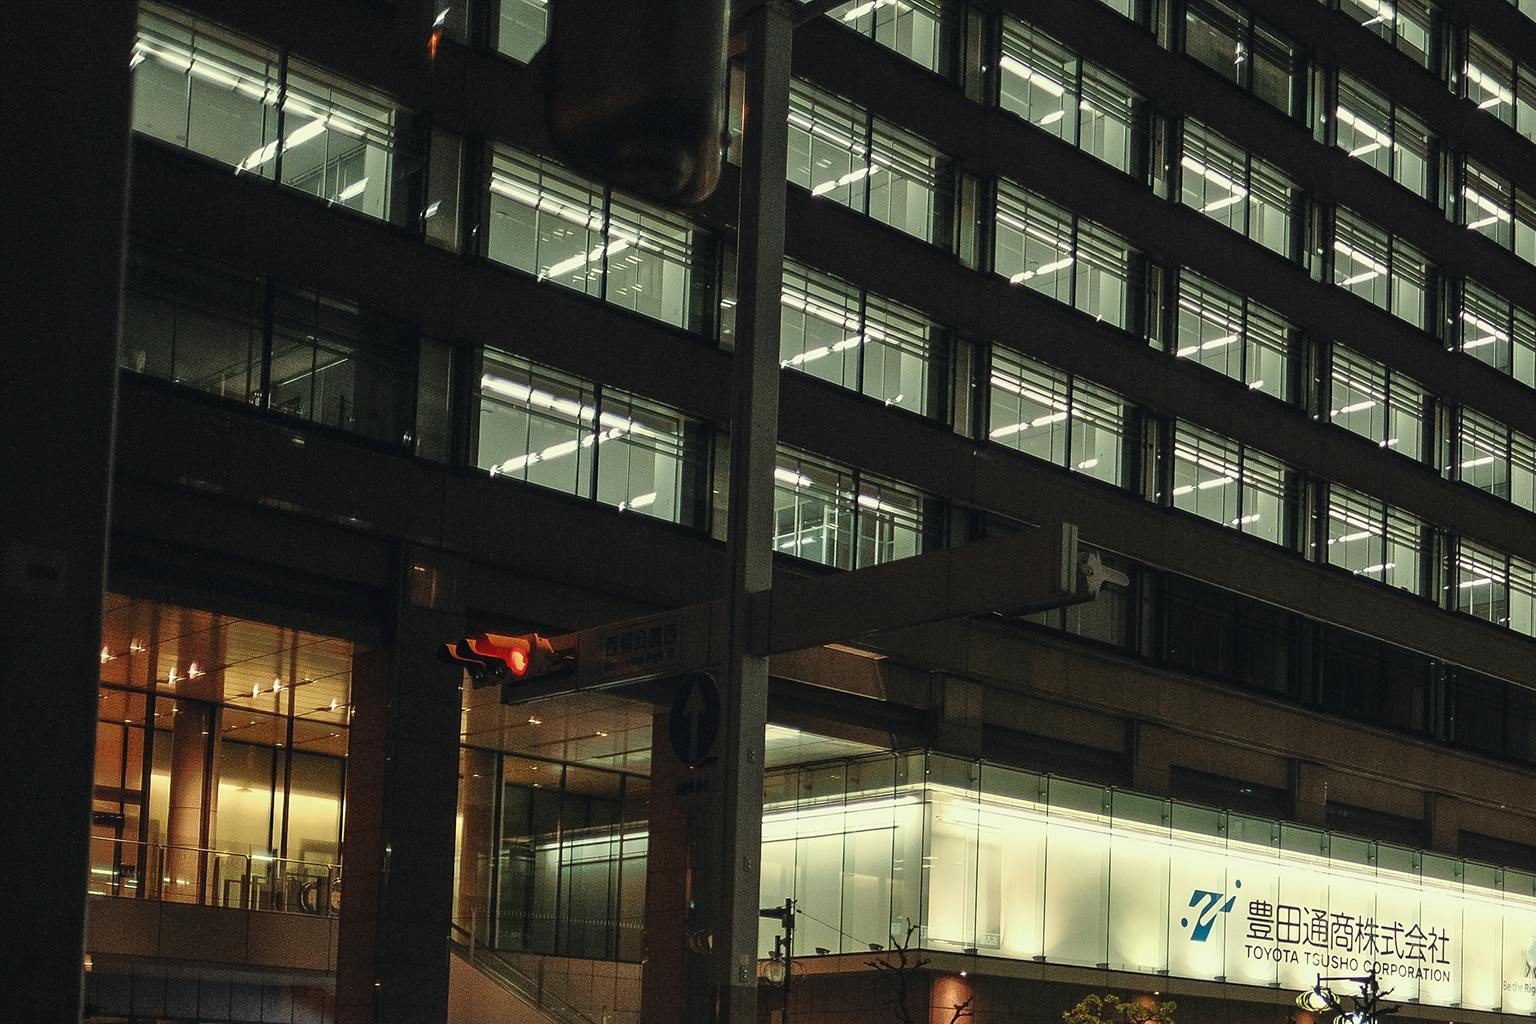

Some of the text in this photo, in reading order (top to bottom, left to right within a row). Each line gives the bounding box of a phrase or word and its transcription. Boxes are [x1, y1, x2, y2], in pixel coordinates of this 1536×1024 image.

[1246, 899, 1451, 965] 豊田通商株式会社
[1244, 944, 1451, 983] TOYOTA TSUSHO CORPORATION
